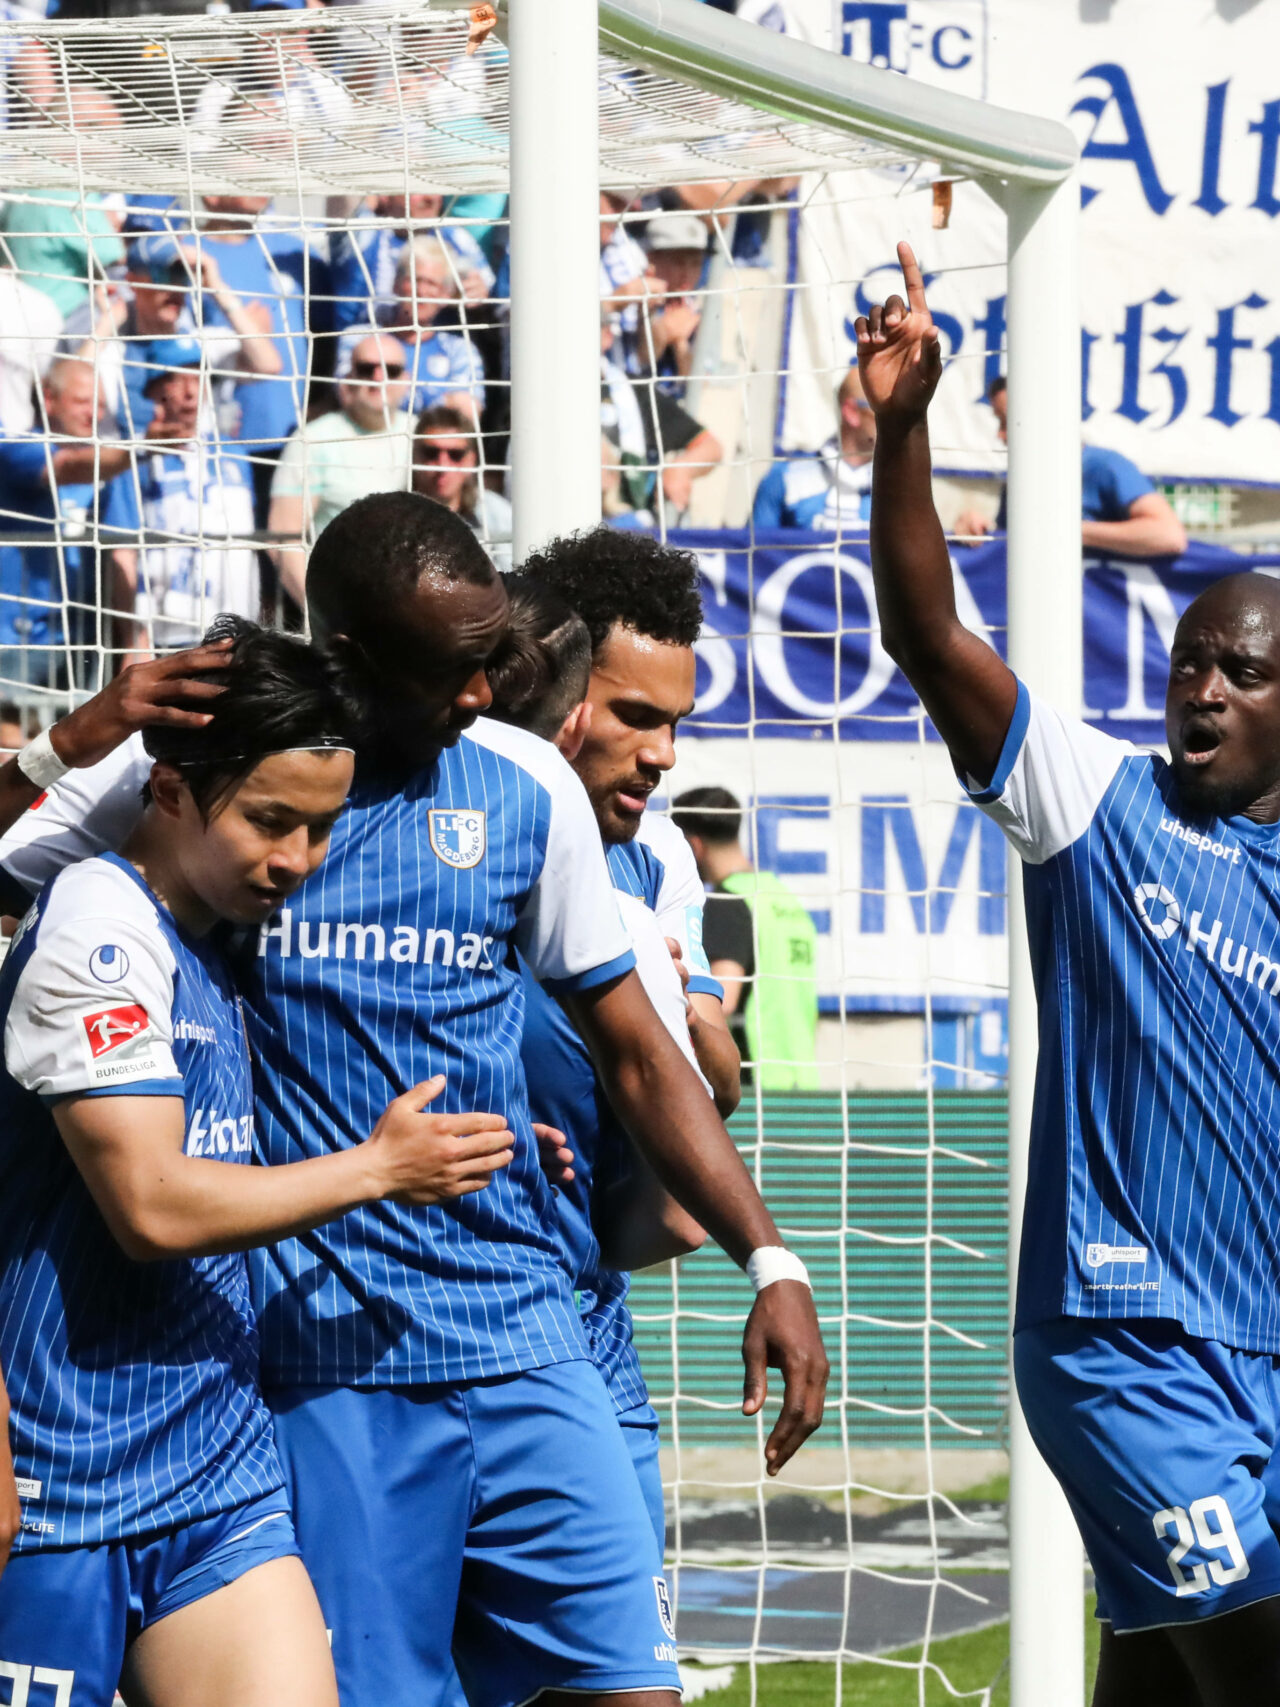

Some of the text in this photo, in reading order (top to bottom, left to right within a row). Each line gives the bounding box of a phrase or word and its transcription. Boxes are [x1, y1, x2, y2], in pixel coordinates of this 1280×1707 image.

[436, 832, 480, 863] MAGDEBURG
[1161, 817, 1242, 865] uhlsport
[95, 1060, 158, 1079] BUNDESLIGA
[1152, 1494, 1251, 1598] 29
